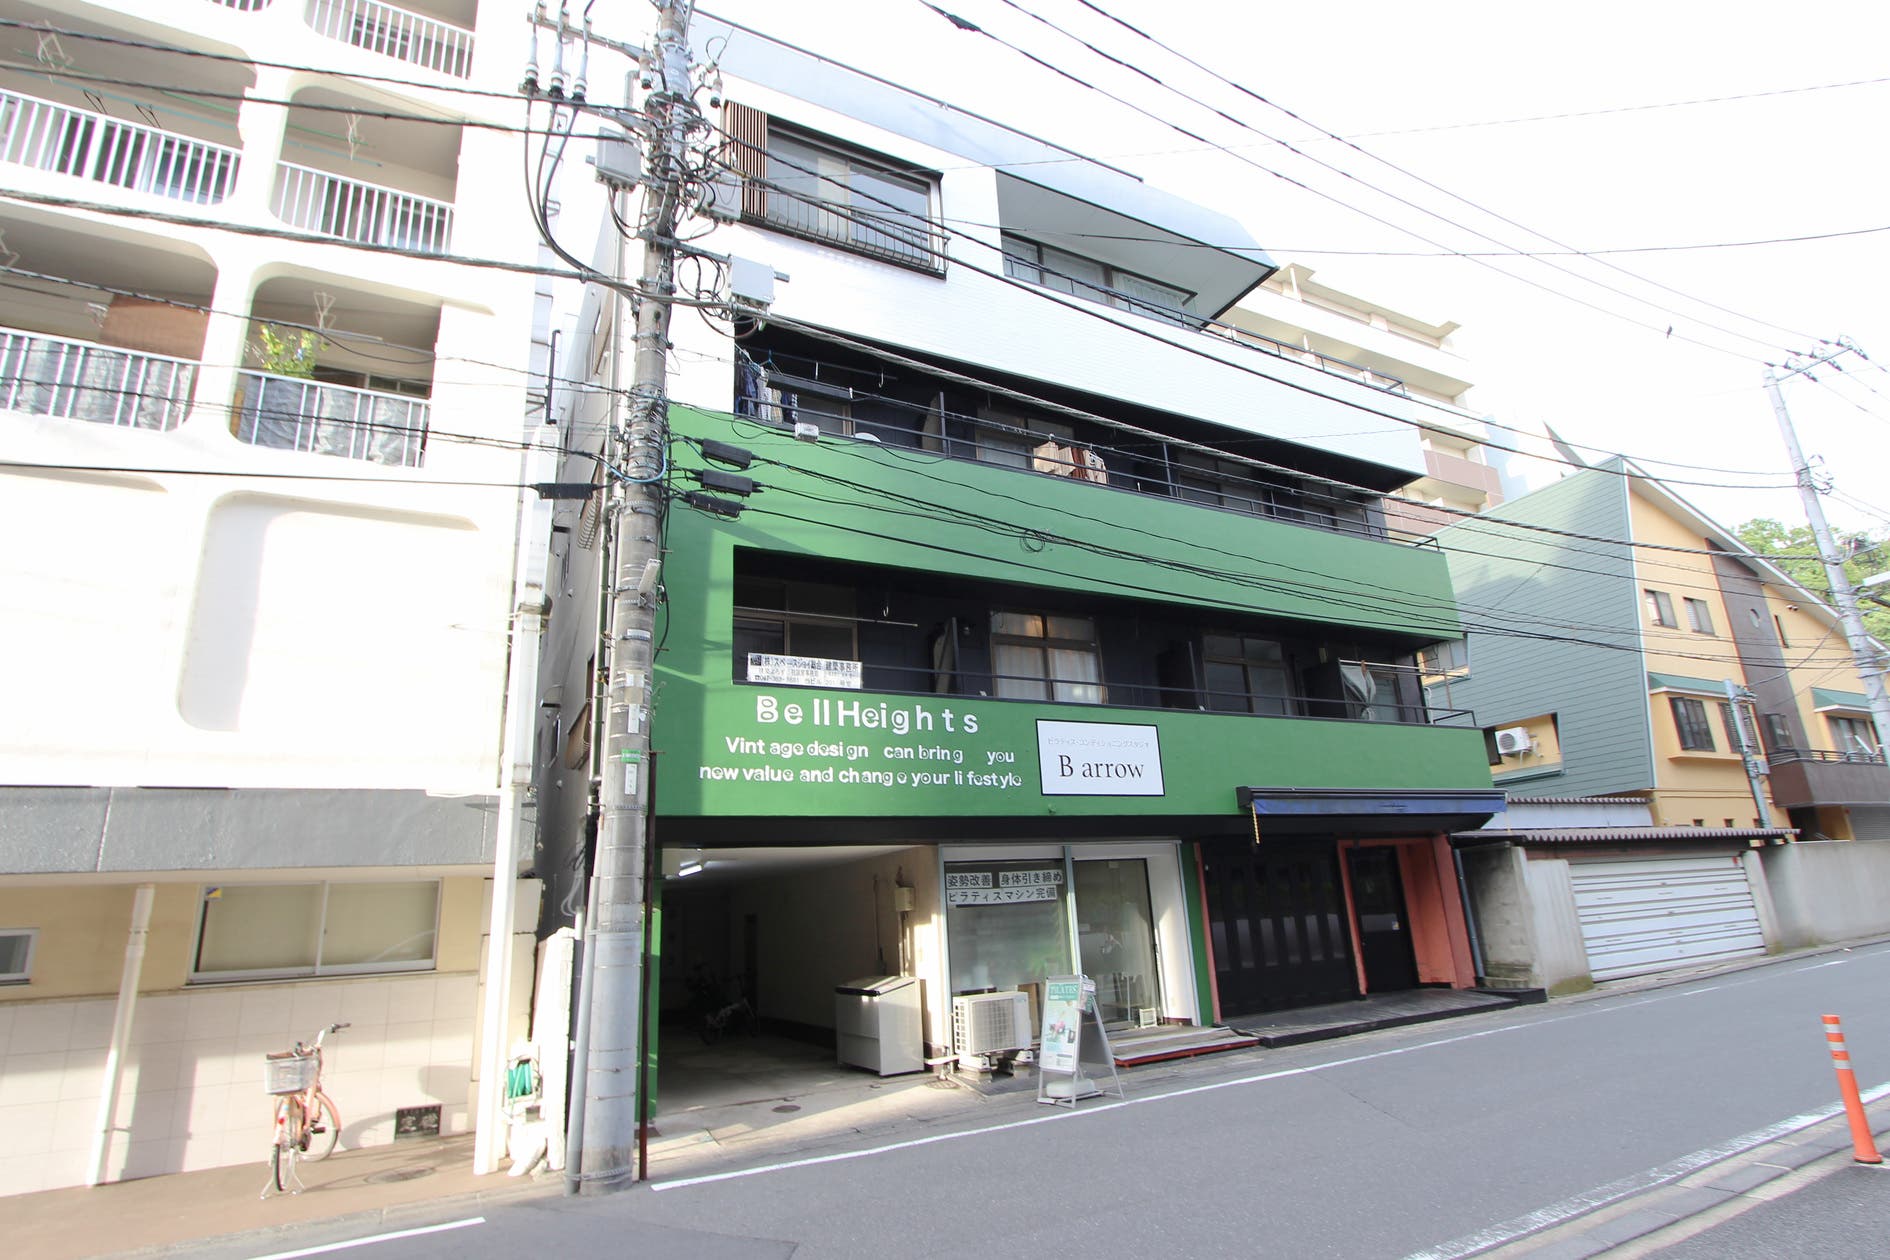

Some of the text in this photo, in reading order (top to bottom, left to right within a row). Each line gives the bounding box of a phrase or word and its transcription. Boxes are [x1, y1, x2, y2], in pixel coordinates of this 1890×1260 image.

[725, 736, 1015, 765] Vintage design can bring you
[699, 765, 1022, 789] new value and change your lifestyle
[947, 871, 1062, 888] 姿勢改善 身体引き締め
[947, 887, 1057, 903] ピラティスマシン完備
